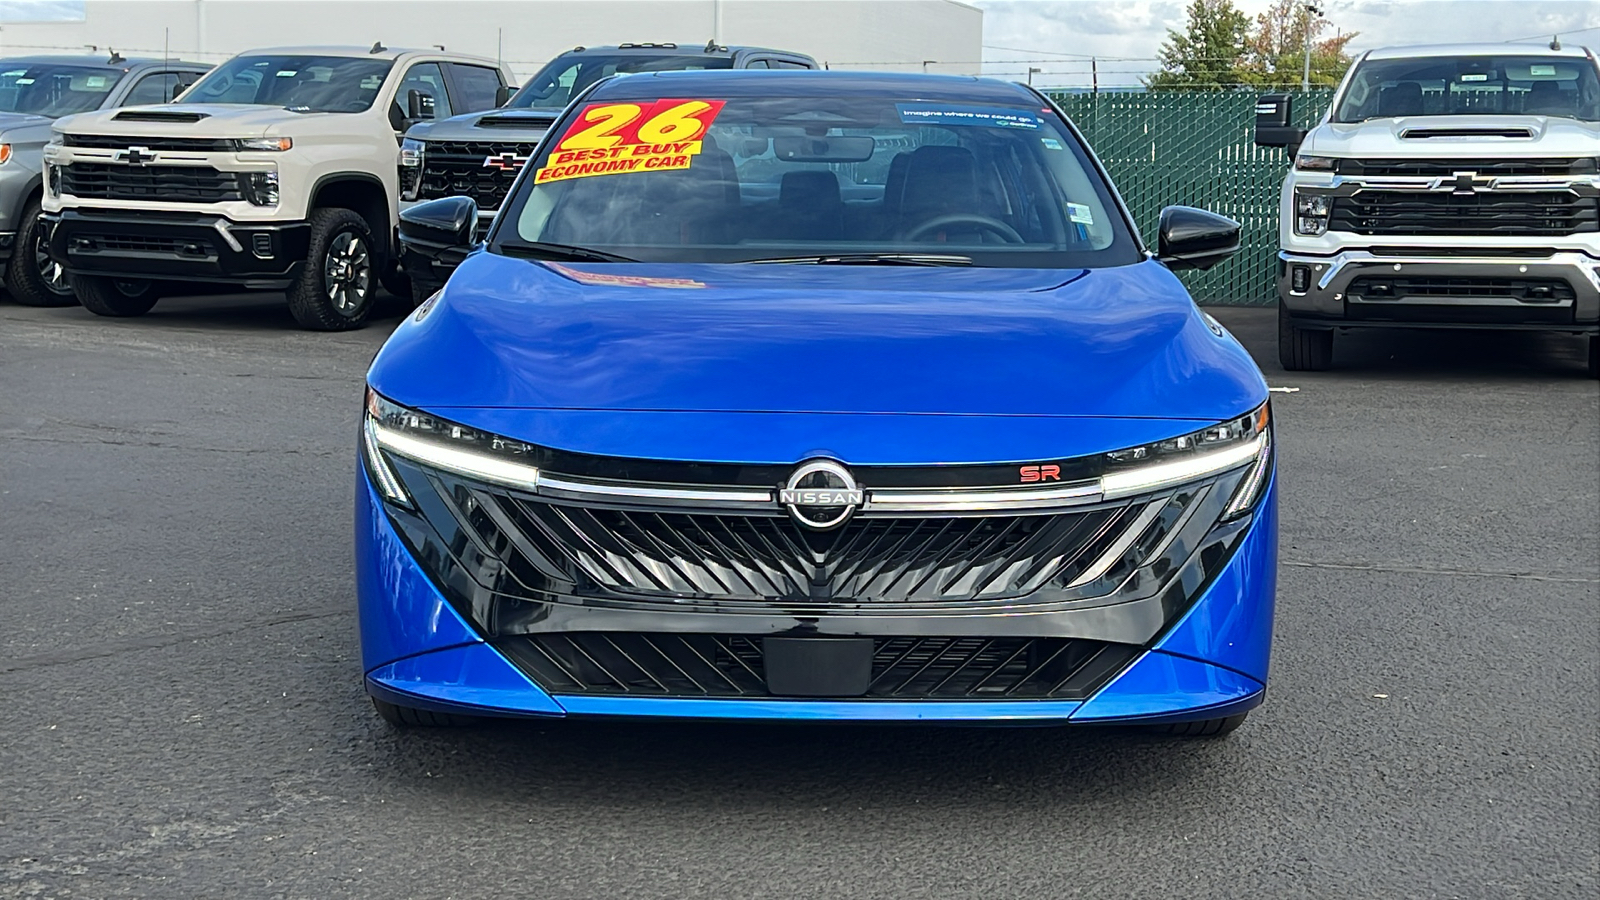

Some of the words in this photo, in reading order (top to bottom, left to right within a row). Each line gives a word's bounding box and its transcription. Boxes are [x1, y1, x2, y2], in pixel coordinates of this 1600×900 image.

[560, 101, 713, 149] 26
[556, 147, 628, 164] BEST
[634, 142, 692, 155] BUY
[538, 159, 642, 181] ECONOMY
[645, 155, 690, 168] CAR
[1020, 465, 1061, 482] SR
[780, 491, 862, 504] NISSAN
